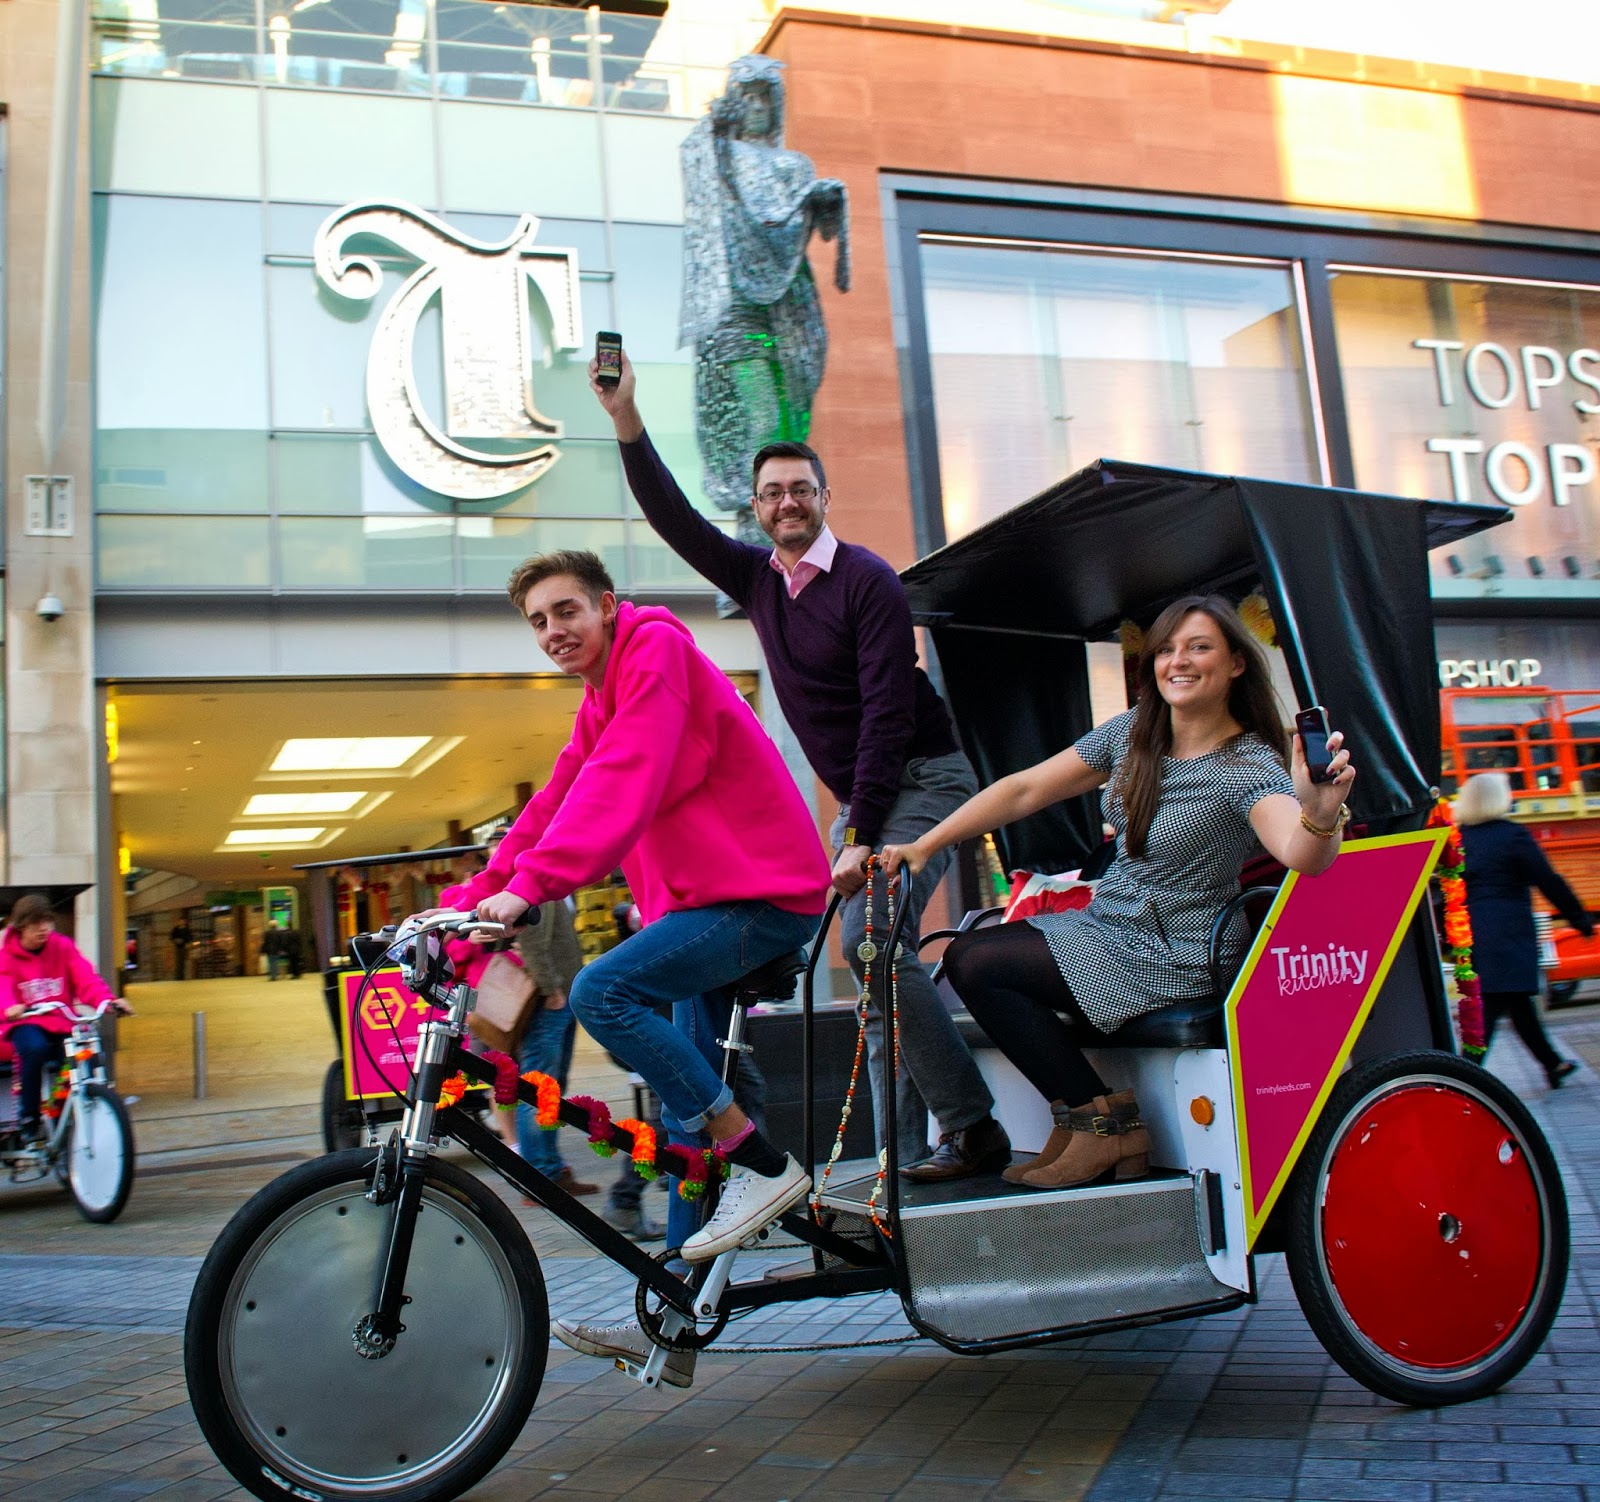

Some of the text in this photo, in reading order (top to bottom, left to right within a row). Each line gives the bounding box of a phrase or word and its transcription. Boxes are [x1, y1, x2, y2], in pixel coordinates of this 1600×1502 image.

[1412, 338, 1600, 414] TOPS
[1426, 438, 1595, 507] TOP
[1270, 942, 1368, 985] Trinity
[1277, 966, 1358, 997] kitchen
[1256, 1083, 1311, 1095] trinityleeds.com
